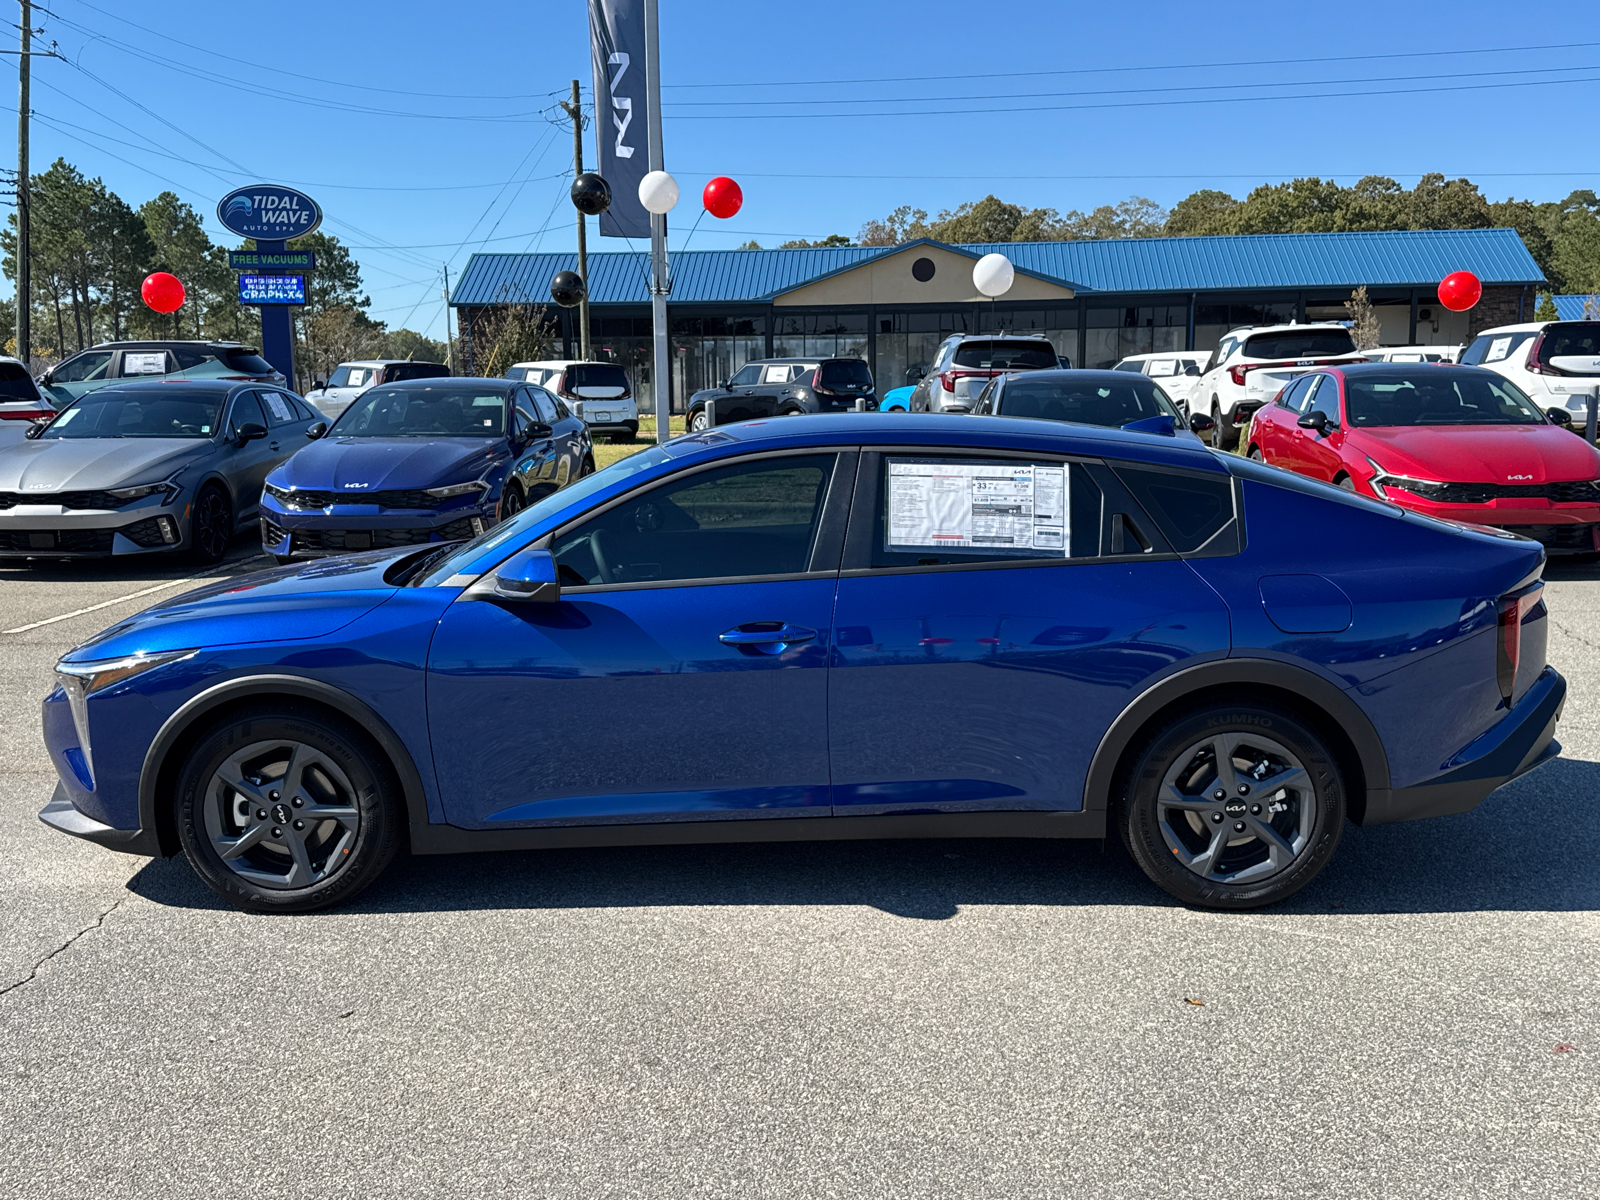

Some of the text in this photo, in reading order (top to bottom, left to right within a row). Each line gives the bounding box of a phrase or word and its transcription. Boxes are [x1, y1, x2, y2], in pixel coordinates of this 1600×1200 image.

[253, 196, 300, 209] TIDAL
[261, 210, 310, 224] WAVE
[233, 255, 308, 264] FREE VACUUMS
[242, 290, 303, 299] GRAPH-X4
[976, 482, 987, 490] 33
[1206, 713, 1273, 728] KUMHO
[311, 861, 362, 904] KUMHO
